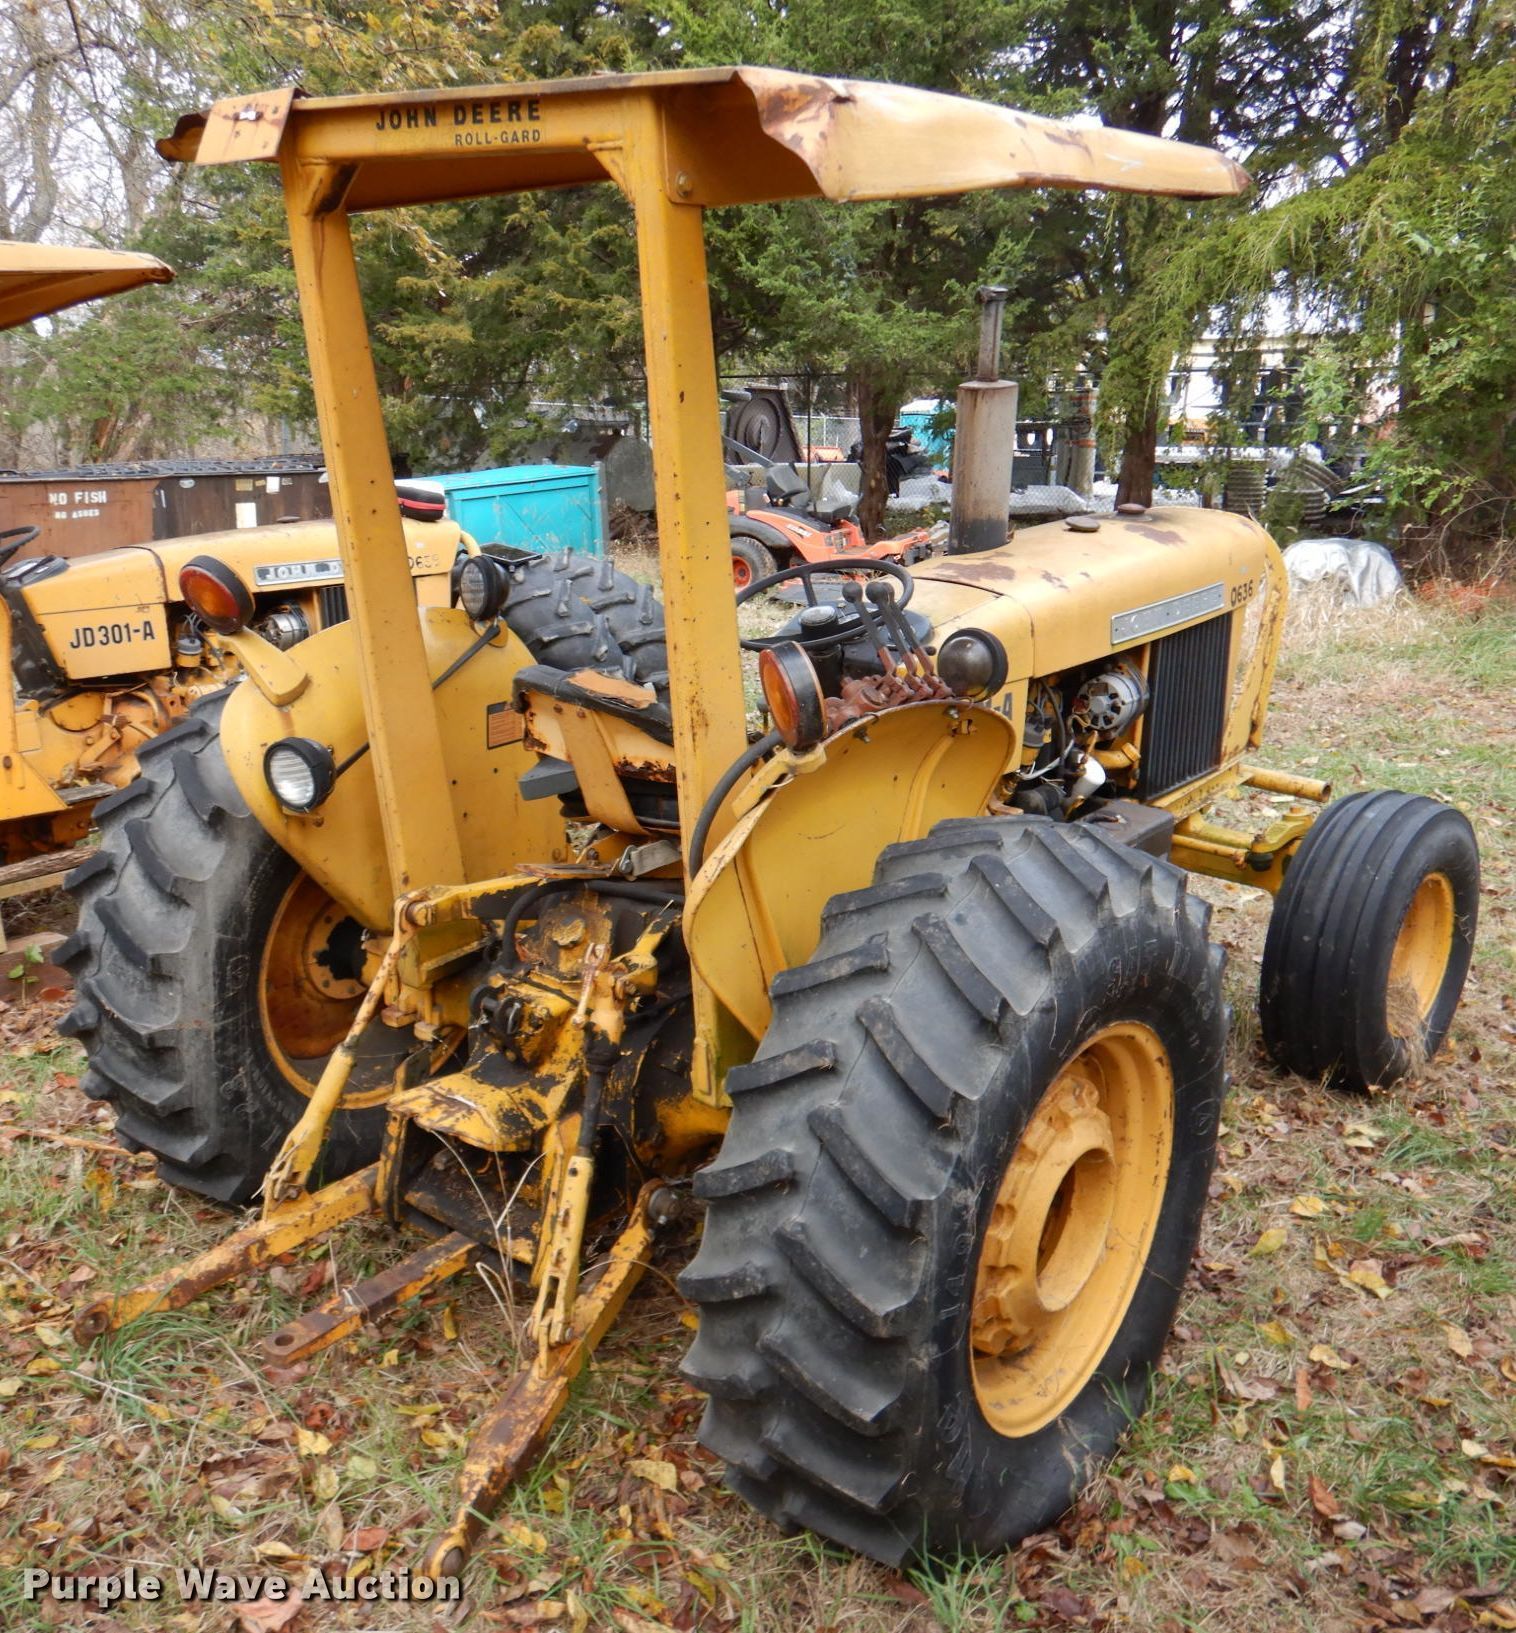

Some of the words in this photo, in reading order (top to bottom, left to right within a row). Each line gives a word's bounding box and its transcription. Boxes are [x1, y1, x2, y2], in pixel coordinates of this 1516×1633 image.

[376, 106, 437, 131] JOHN
[454, 100, 541, 126] DEERE
[455, 129, 541, 147] ROLL-GARD
[48, 491, 68, 506] NO
[74, 490, 107, 504] FISH
